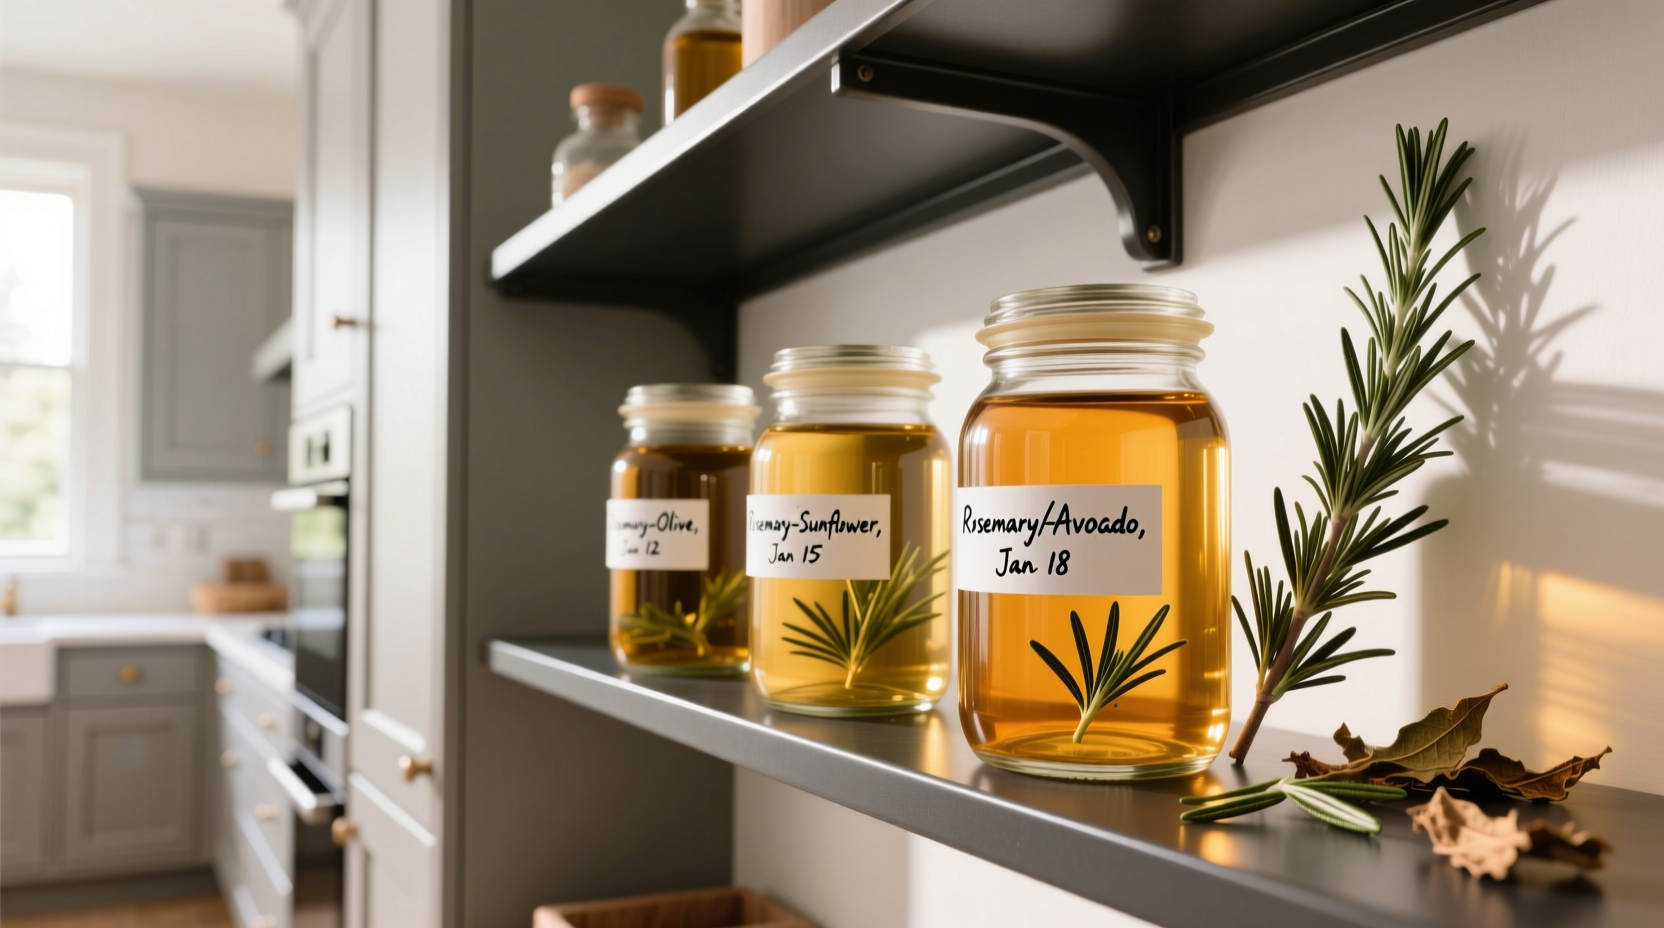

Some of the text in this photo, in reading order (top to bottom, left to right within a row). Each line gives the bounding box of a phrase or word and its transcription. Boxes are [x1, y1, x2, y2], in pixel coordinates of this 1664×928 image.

[645, 540, 661, 556] 12
[768, 543, 823, 564] Jan 15
[995, 547, 1071, 577] Jan 18
